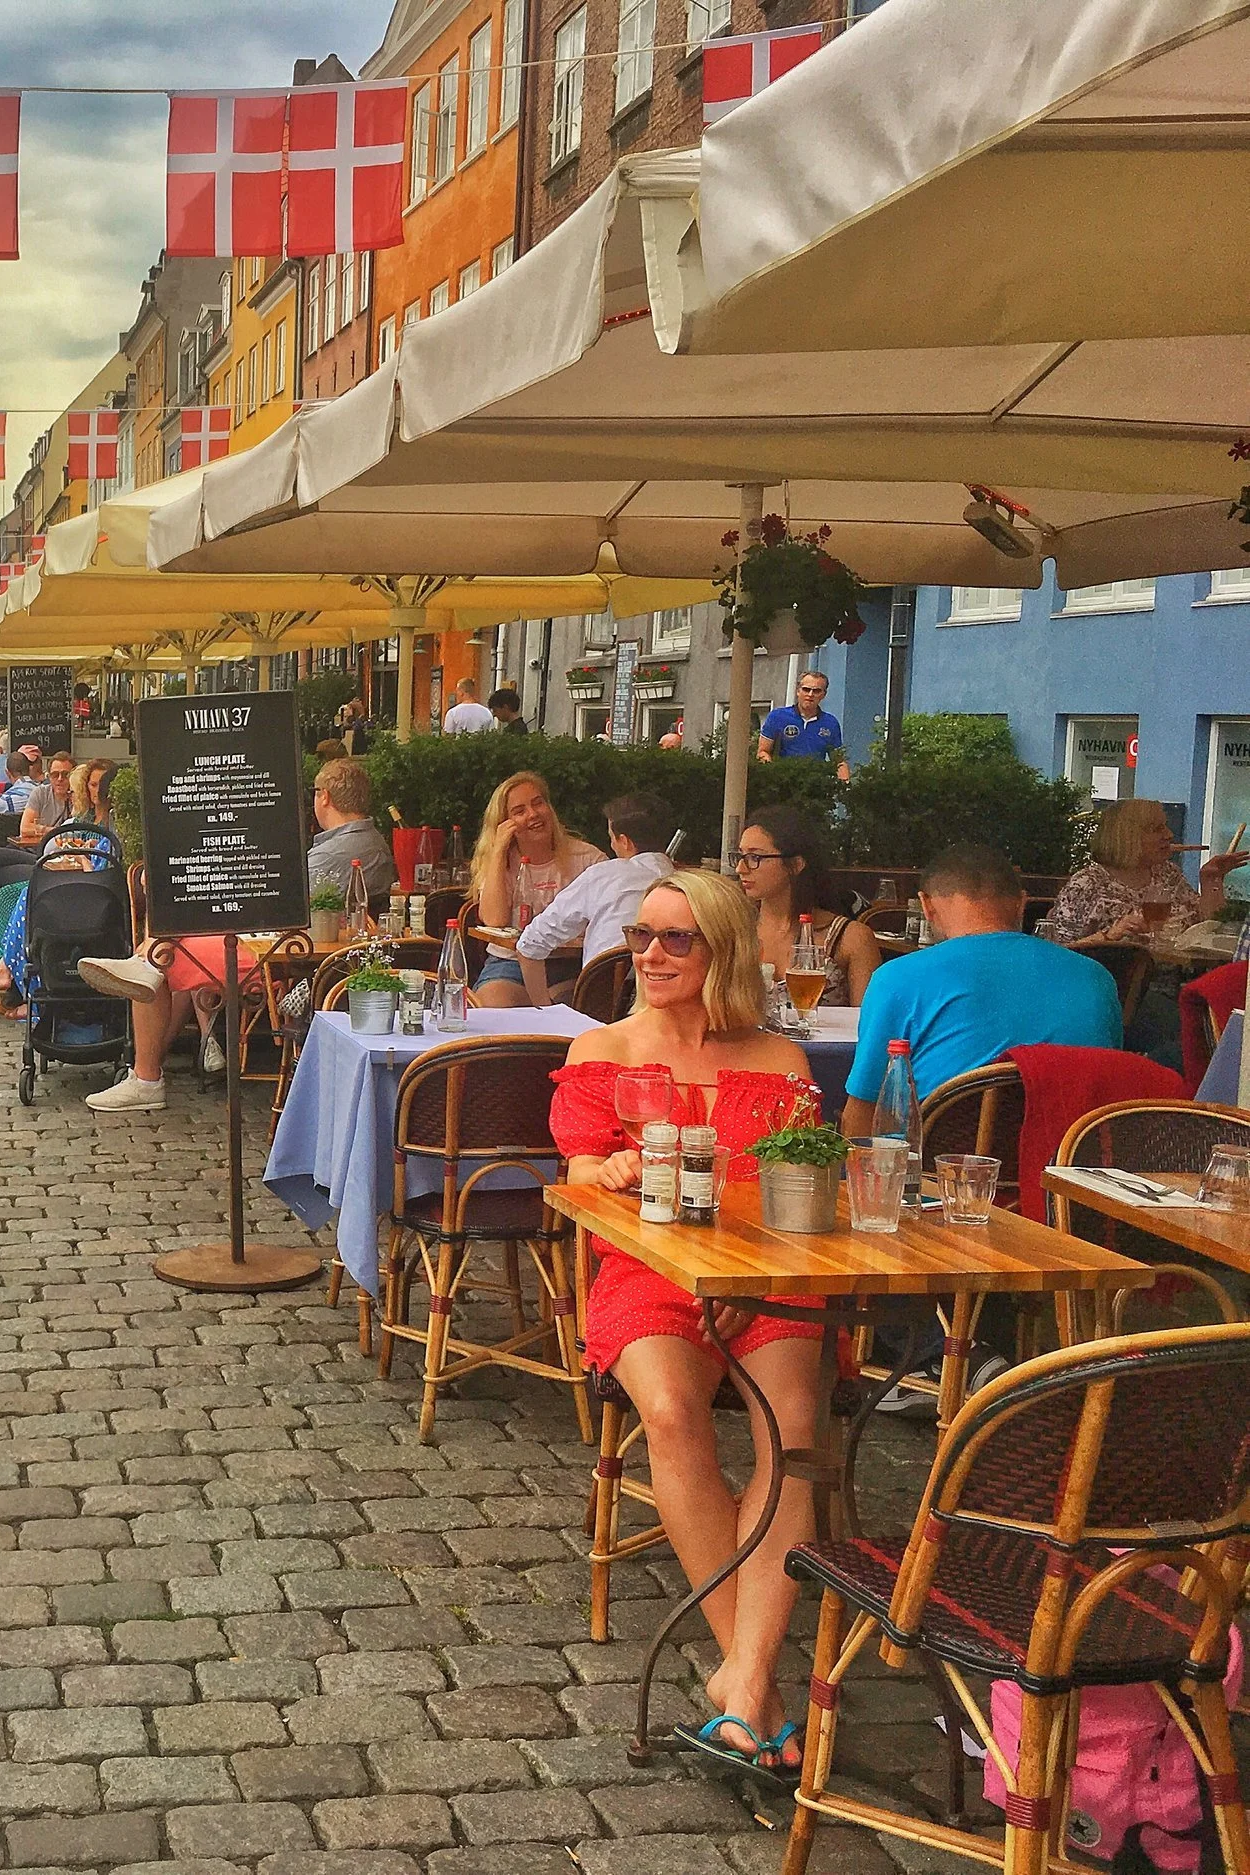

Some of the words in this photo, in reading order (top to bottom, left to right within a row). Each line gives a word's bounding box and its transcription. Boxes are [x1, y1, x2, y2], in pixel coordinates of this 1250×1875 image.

[14, 682, 31, 690] PINK
[185, 708, 229, 730] NYHAVN
[232, 707, 251, 727] 37
[1079, 740, 1126, 752] NYHAVN
[194, 756, 220, 766] LUNCH
[222, 754, 246, 764] PLATE
[172, 775, 183, 784] Egg
[184, 775, 195, 783] and
[196, 774, 220, 782] shrimps
[168, 784, 197, 793] Roastbeef
[162, 795, 177, 803] Fried
[193, 793, 200, 801] of
[203, 837, 221, 847] FISH
[222, 835, 246, 845] PLATE
[169, 856, 199, 865] Marinated
[186, 865, 211, 873] Shrimps
[186, 883, 210, 892] Smoked
[211, 883, 233, 891] Salmon
